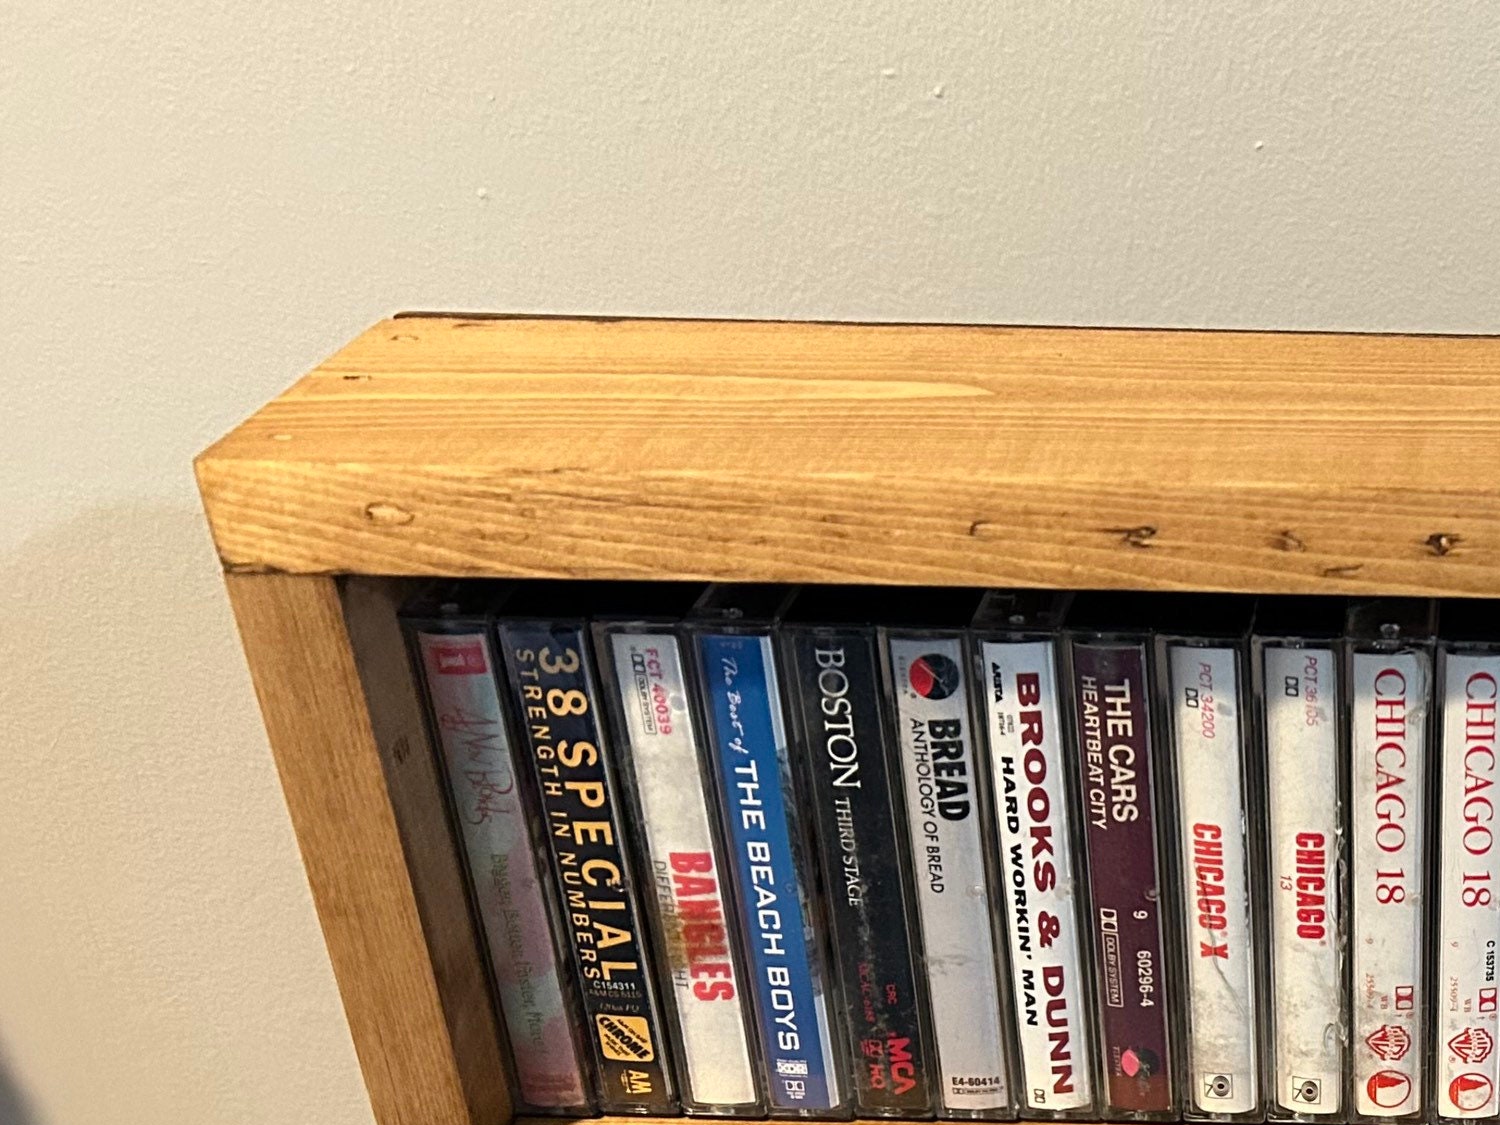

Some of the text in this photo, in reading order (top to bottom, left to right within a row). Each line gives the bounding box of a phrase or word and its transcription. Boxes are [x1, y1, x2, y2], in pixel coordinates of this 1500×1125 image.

[513, 647, 600, 978] STRENGTH IN NUMBERS
[813, 648, 863, 906] BOSTON THIRD STAGE
[926, 718, 971, 821] BREAD
[1079, 674, 1107, 830] HEARTBEAT CITY
[1103, 678, 1138, 822] THE CARS
[1371, 667, 1410, 905] CHICAGO 18
[1459, 671, 1500, 908] CHICAGO 18
[554, 739, 640, 981] SPECIAL
[667, 850, 736, 1001] BANGLES
[732, 760, 801, 1051] THE BEACH BOYS
[1015, 671, 1074, 1094] BROOKS & DUNN
[1190, 822, 1228, 959] CHICAGO X
[1295, 831, 1326, 940] CHICAGO
[597, 1016, 650, 1059] CHROME
